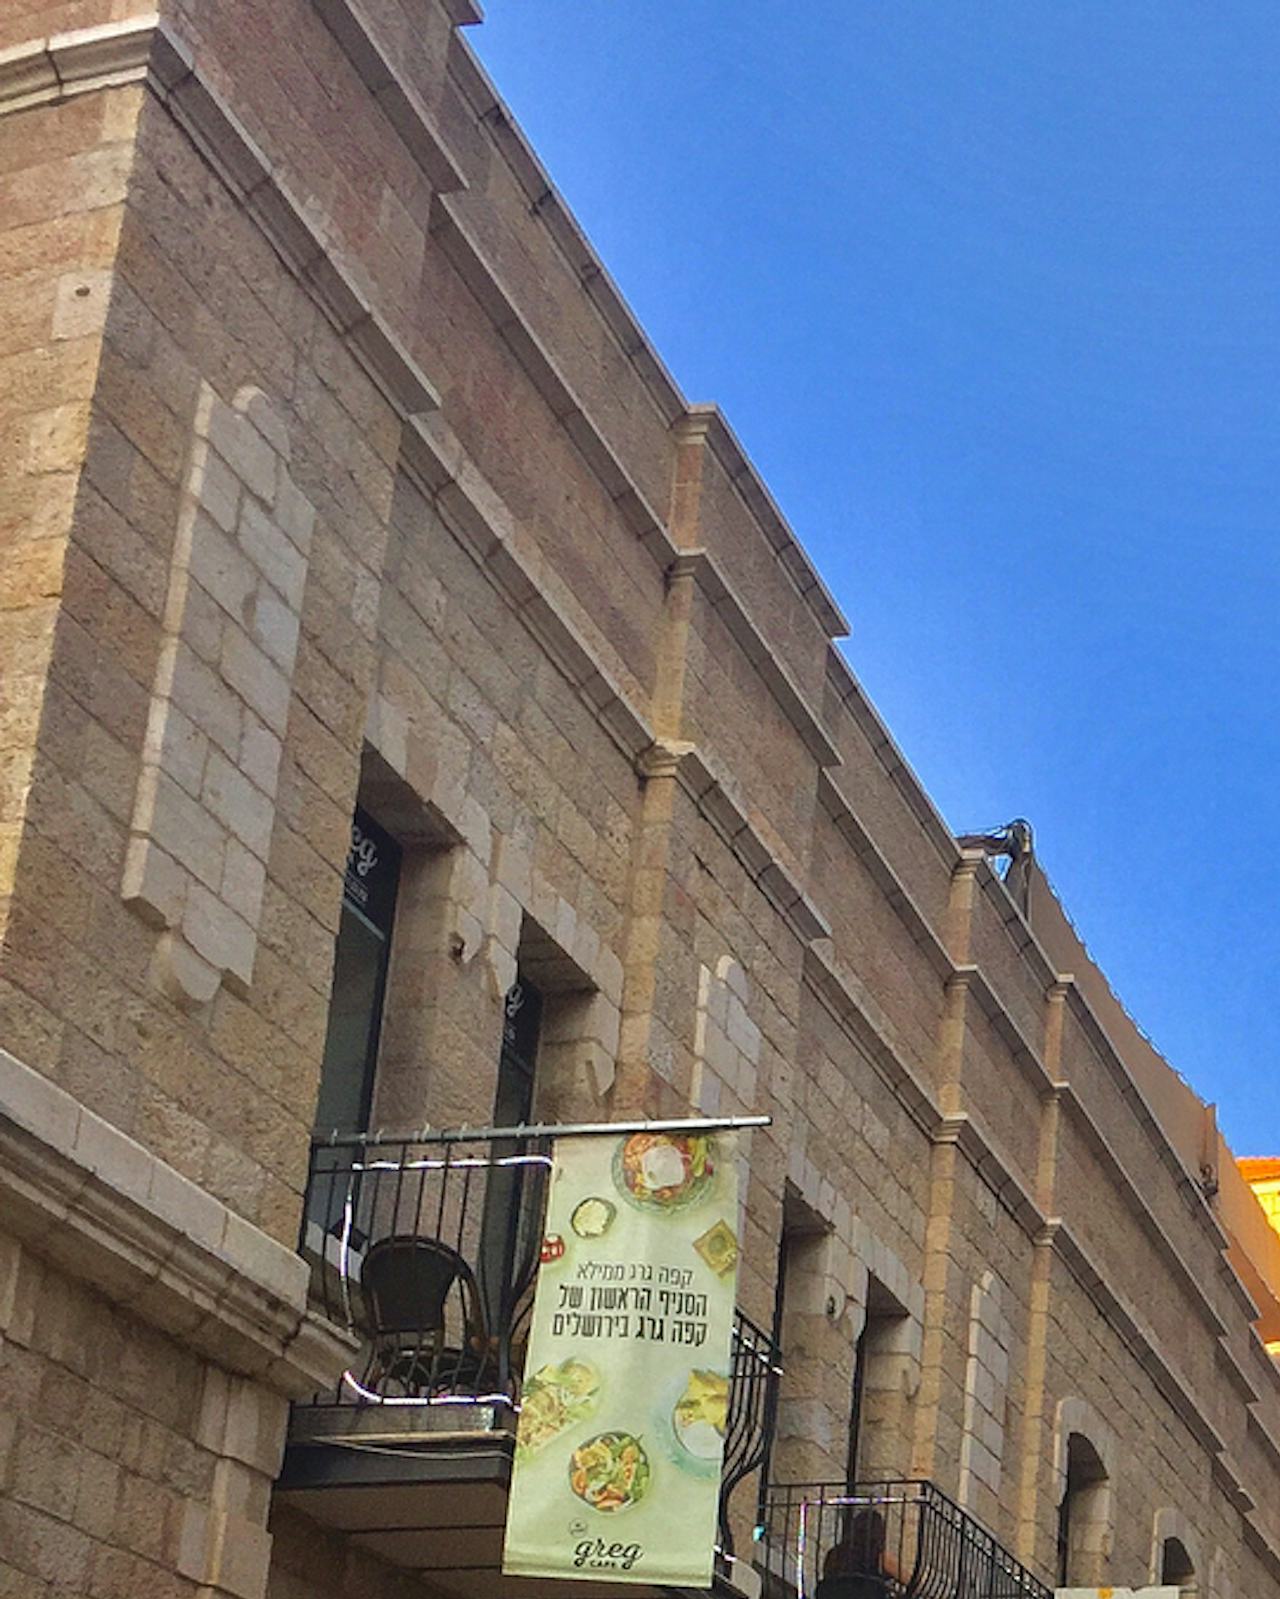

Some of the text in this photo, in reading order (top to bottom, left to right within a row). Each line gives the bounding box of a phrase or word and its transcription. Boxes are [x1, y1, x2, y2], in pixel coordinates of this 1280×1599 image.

[577, 1261, 626, 1281] ממילא
[658, 1266, 693, 1289] קפה
[559, 1284, 708, 1317] הסניף הראשון של
[552, 1311, 708, 1347] קפה גרג בירושלים
[574, 1538, 645, 1570] greg
